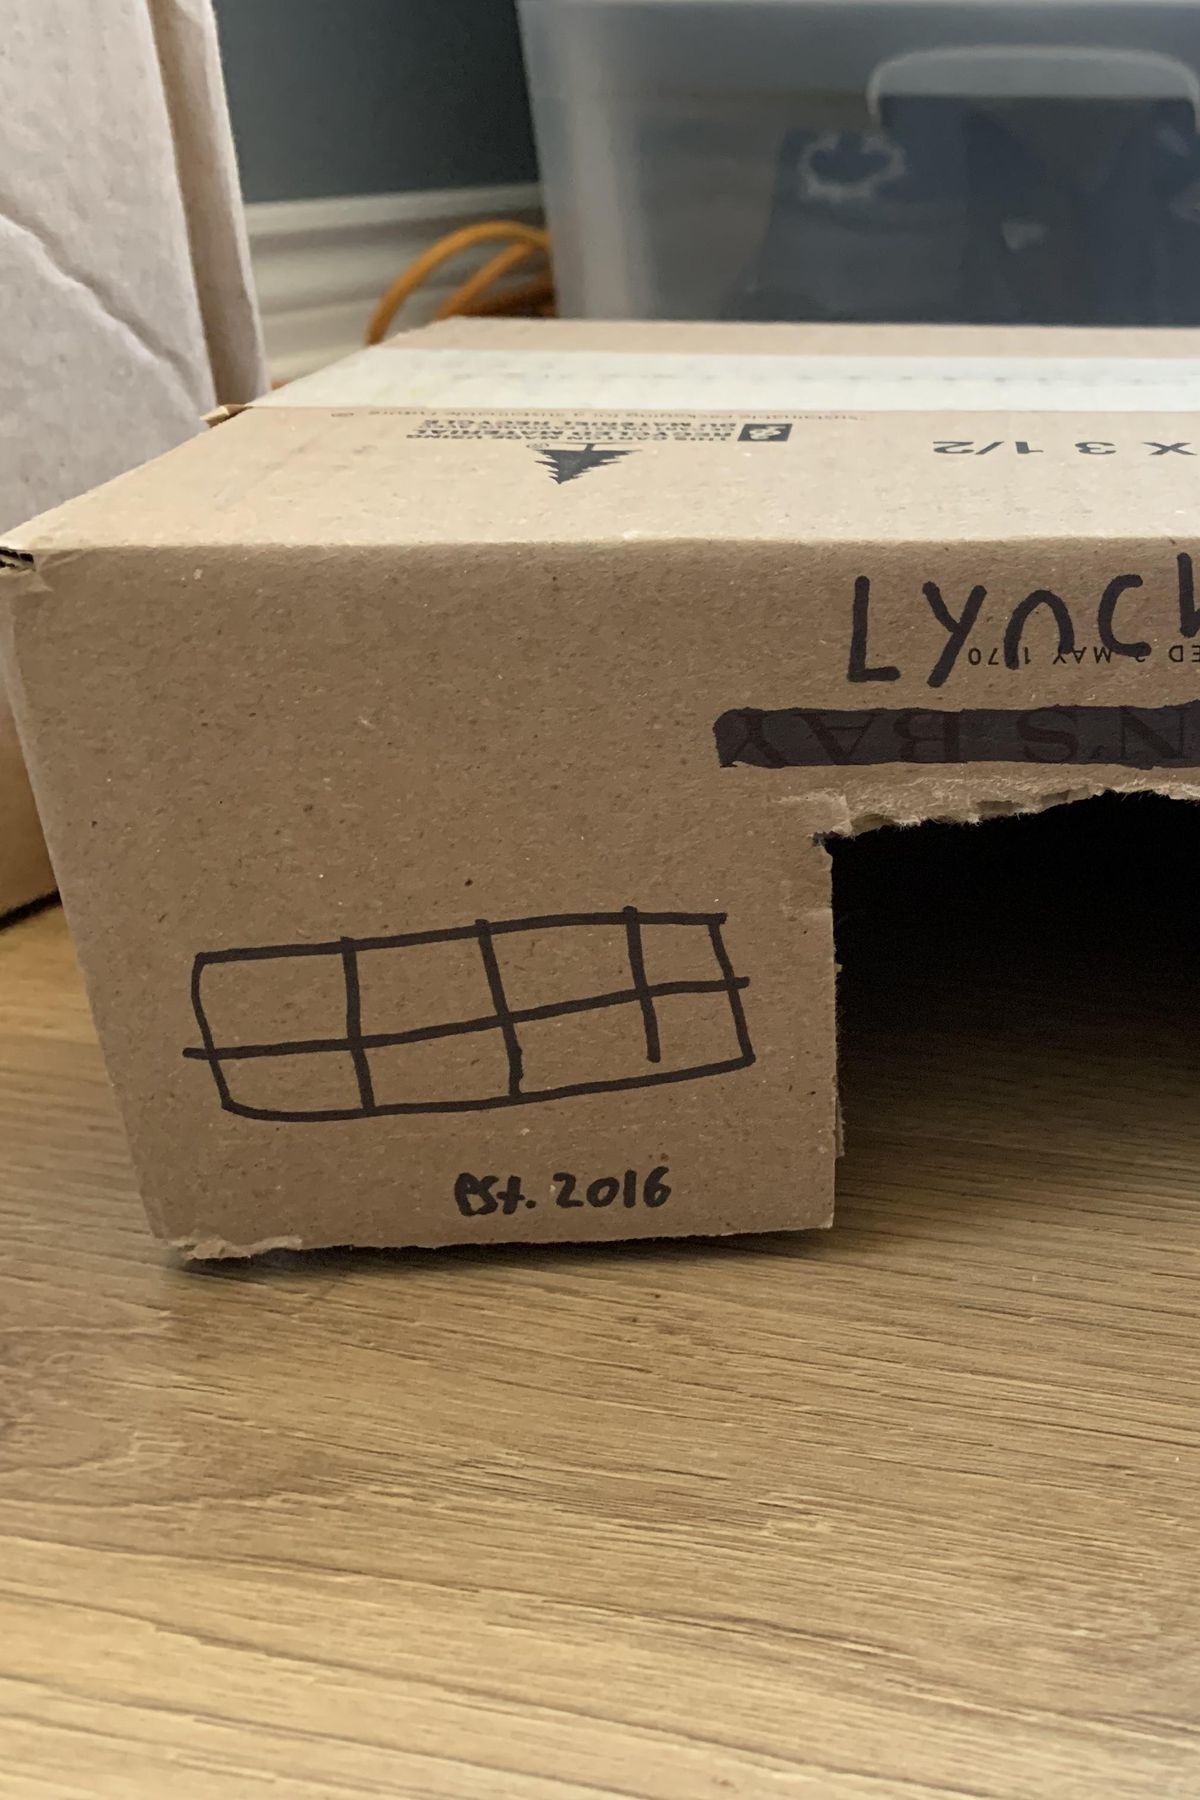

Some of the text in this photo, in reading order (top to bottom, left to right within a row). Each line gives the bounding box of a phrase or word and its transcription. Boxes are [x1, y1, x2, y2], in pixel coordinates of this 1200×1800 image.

[932, 440, 1044, 455] 1/2
[1074, 441, 1117, 455] 3
[1142, 441, 1198, 456] X
[968, 646, 1032, 666] 170
[1052, 646, 1112, 665] MAY
[720, 710, 961, 767] BAY
[553, 1165, 672, 1208] 2016
